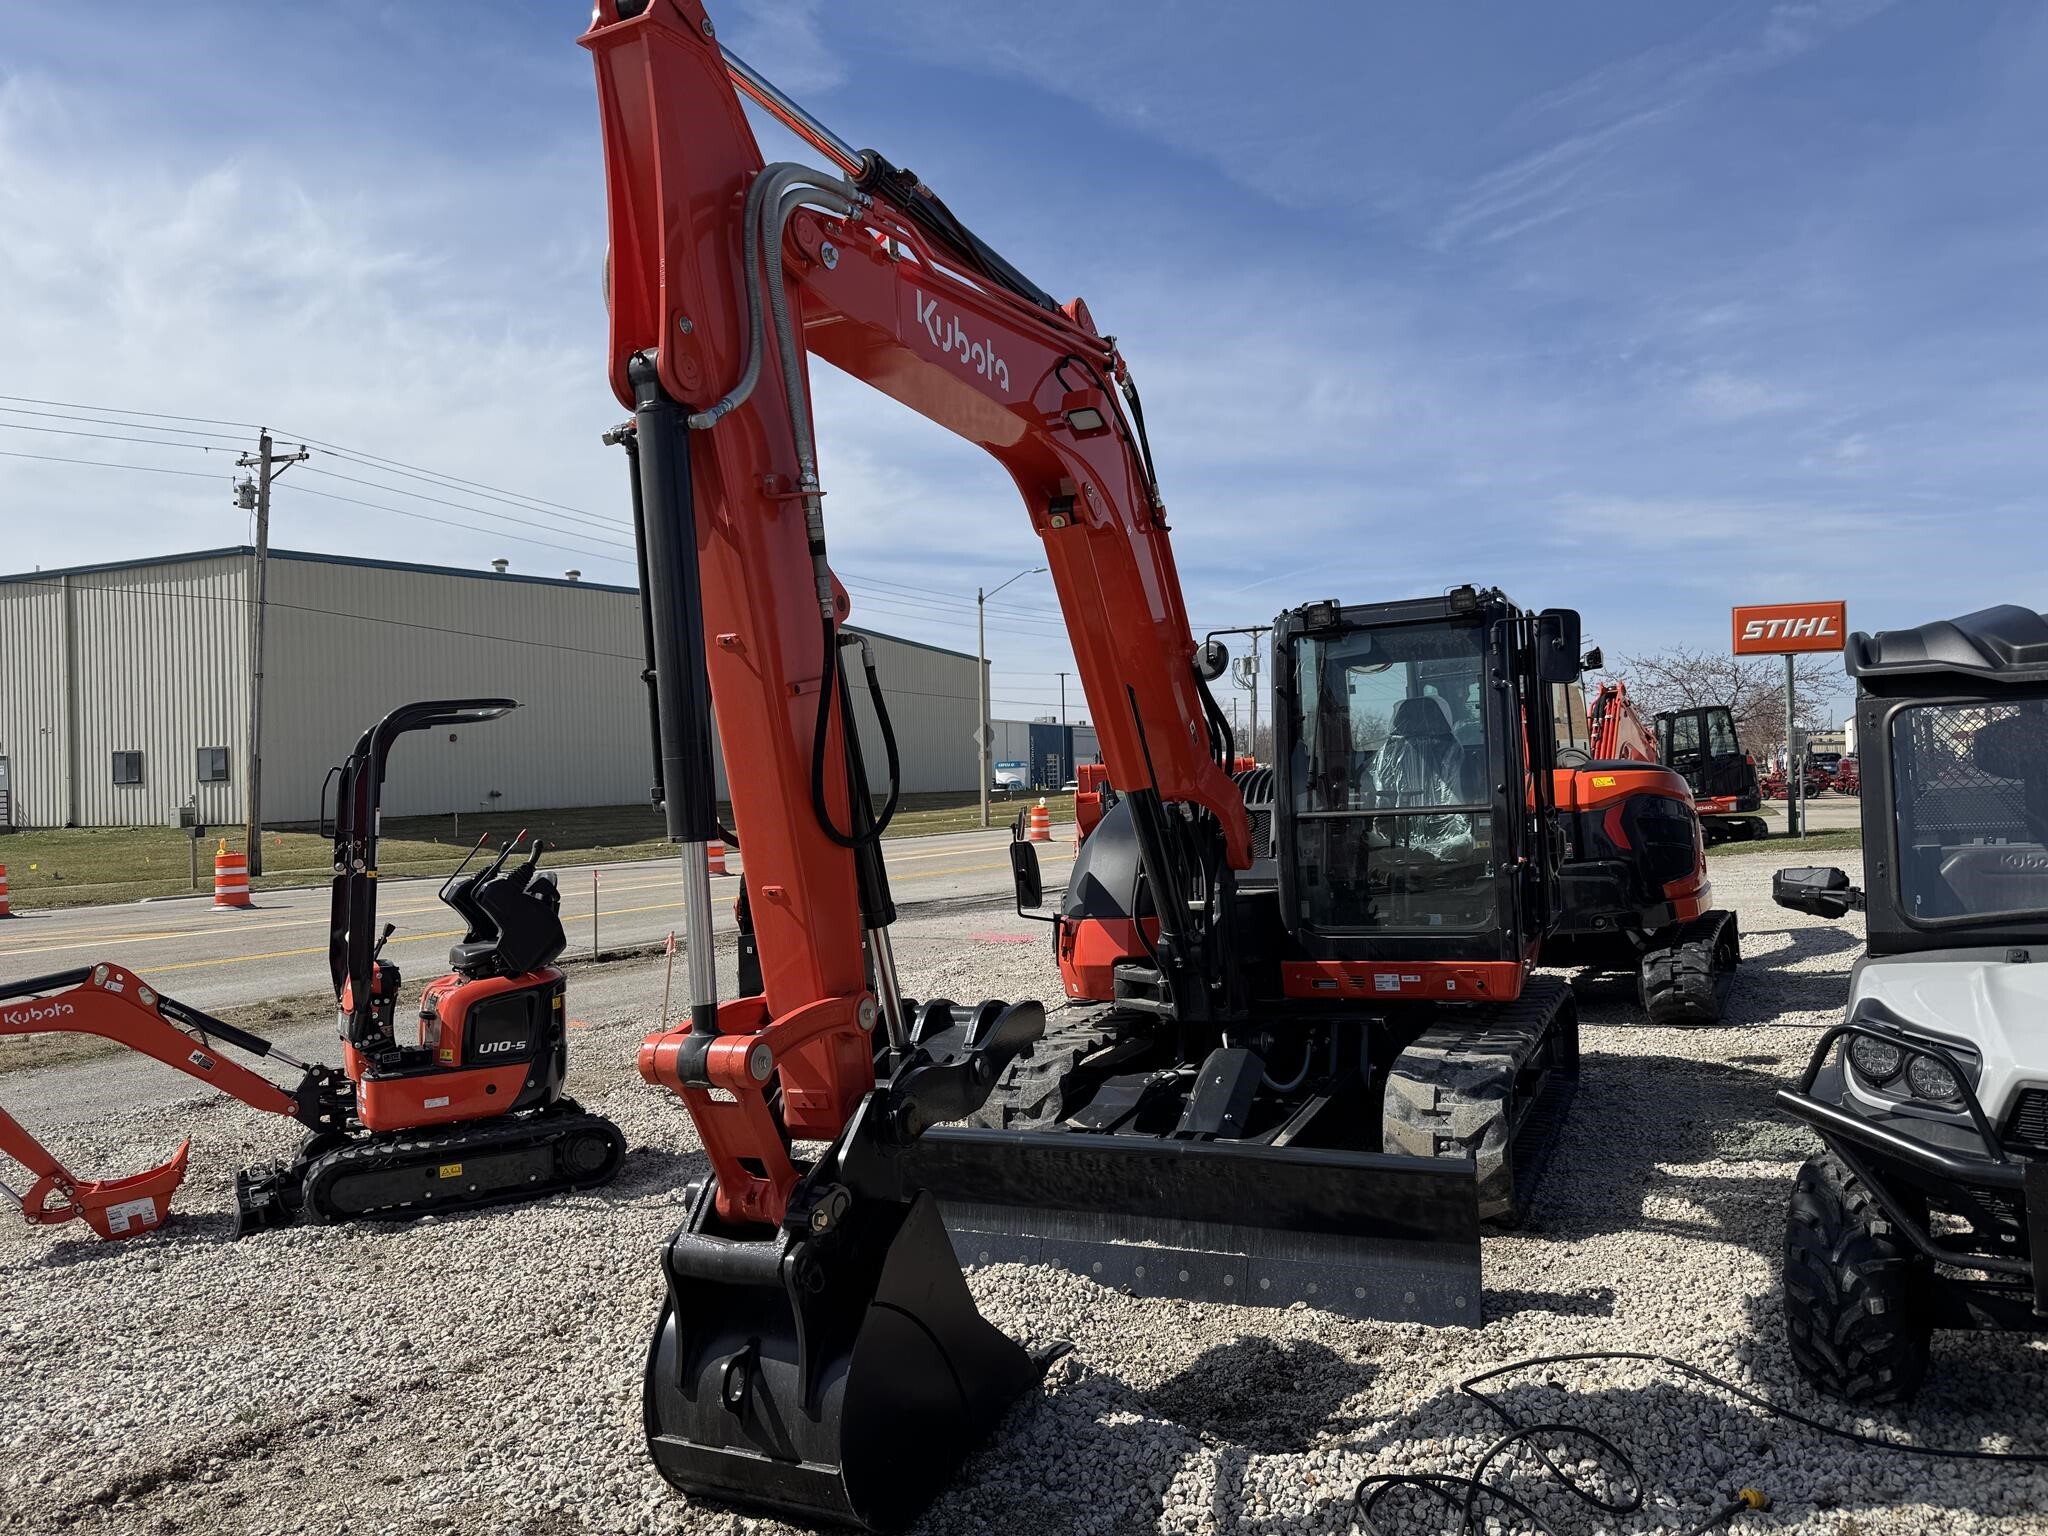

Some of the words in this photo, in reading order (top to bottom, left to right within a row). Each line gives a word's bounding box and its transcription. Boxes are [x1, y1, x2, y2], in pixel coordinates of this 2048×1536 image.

[915, 288, 1010, 393] Kubota
[1741, 616, 1838, 641] STIHL
[3, 1002, 75, 1025] Kubota
[479, 1040, 527, 1054] U10-5
